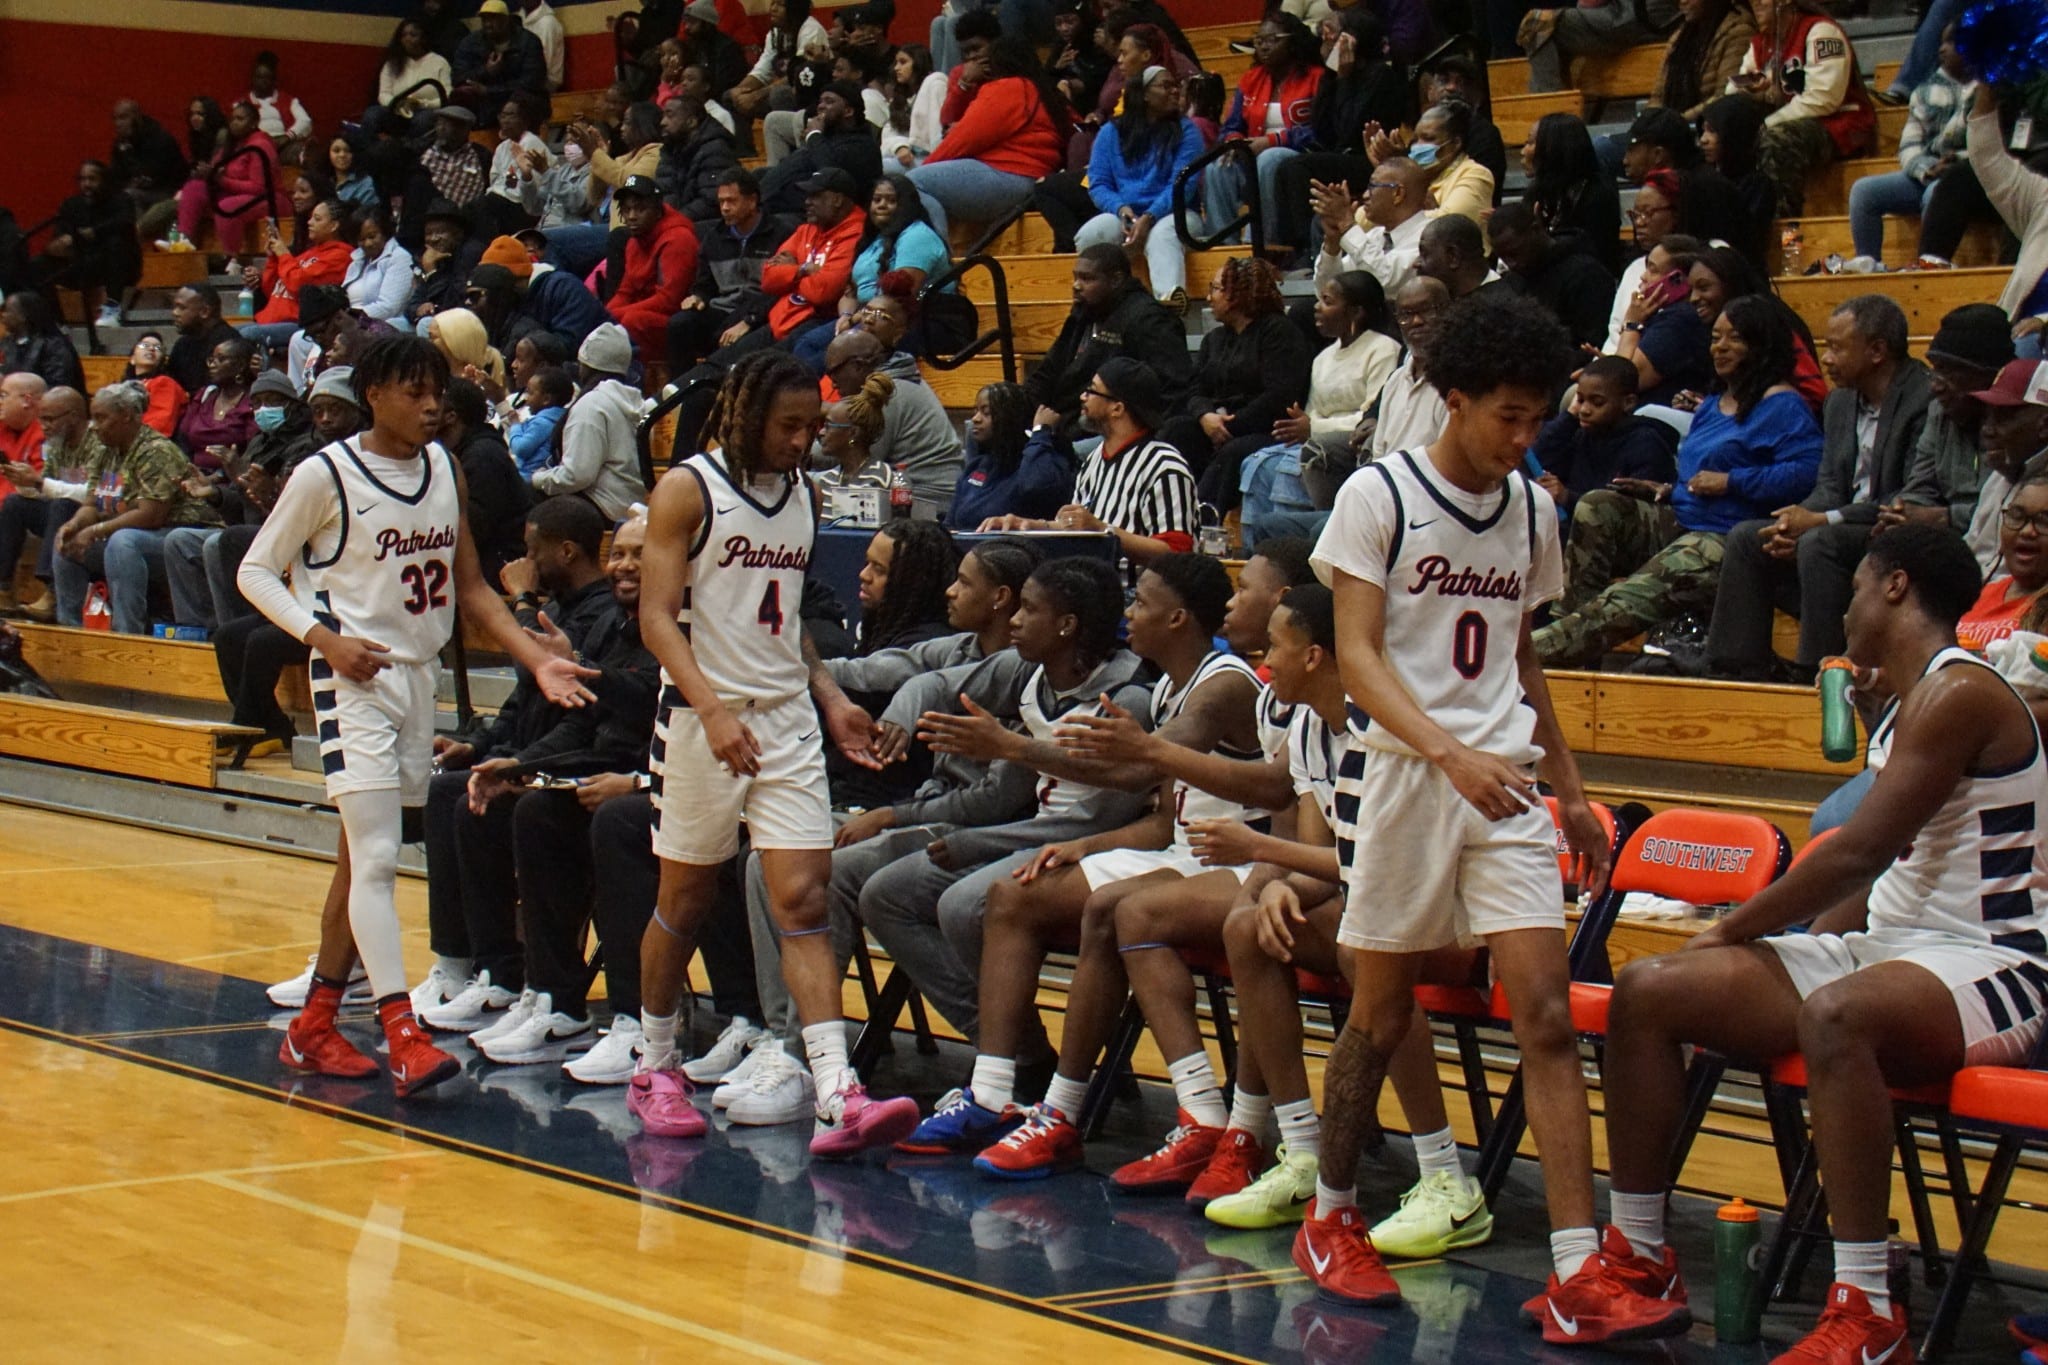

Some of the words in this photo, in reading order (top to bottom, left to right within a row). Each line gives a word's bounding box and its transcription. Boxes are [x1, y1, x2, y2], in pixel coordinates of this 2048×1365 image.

[374, 525, 456, 561] Patriots
[718, 535, 806, 571] Patriots
[401, 559, 449, 615] 32
[1408, 555, 1522, 601] Patriots
[758, 579, 783, 635] 4
[1453, 609, 1488, 680] 0
[1640, 836, 1753, 873] SOUTHWEST
